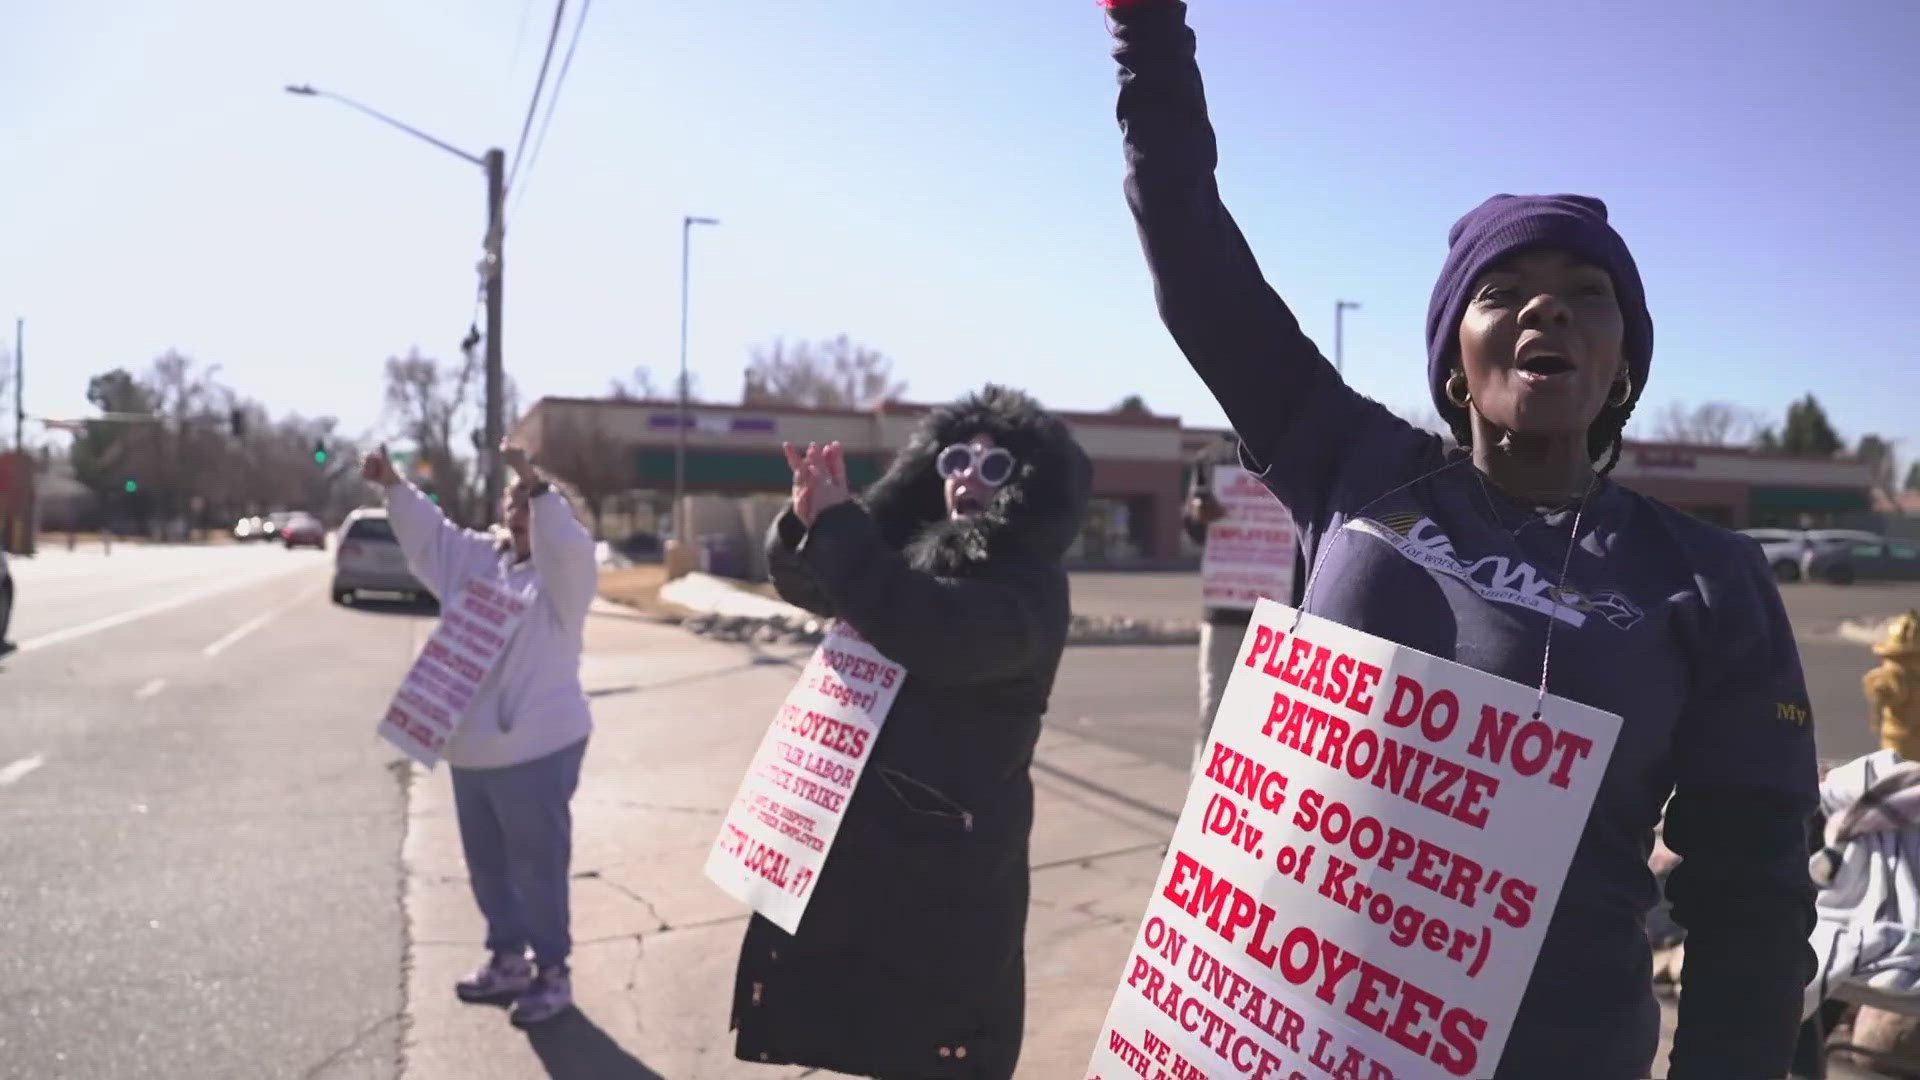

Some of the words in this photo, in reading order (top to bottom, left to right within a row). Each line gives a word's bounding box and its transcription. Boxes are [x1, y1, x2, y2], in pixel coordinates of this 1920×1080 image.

[819, 675, 878, 714] Kroger)
[1244, 623, 1384, 716] PLEASE
[1383, 674, 1460, 743] DO
[1467, 704, 1593, 790] NOT
[1776, 702, 1807, 727] My
[794, 777, 846, 814] STRIKE
[804, 752, 856, 789] LABOR
[1260, 691, 1499, 831] PATRONIZE
[744, 838, 791, 888] LOCAL
[1204, 740, 1290, 816] KING
[1292, 787, 1538, 929] SOOPER'S
[1201, 792, 1265, 861] (Div.
[1275, 844, 1317, 884] of
[1318, 854, 1494, 978] Kroger)
[1143, 916, 1189, 967] ON
[1187, 944, 1306, 1054] UNFAIR
[1162, 849, 1488, 1077] EMPLOYEES
[1109, 1029, 1152, 1080] WITH
[1126, 954, 1282, 1080] PRACTICE
[1142, 1028, 1172, 1067] WE
